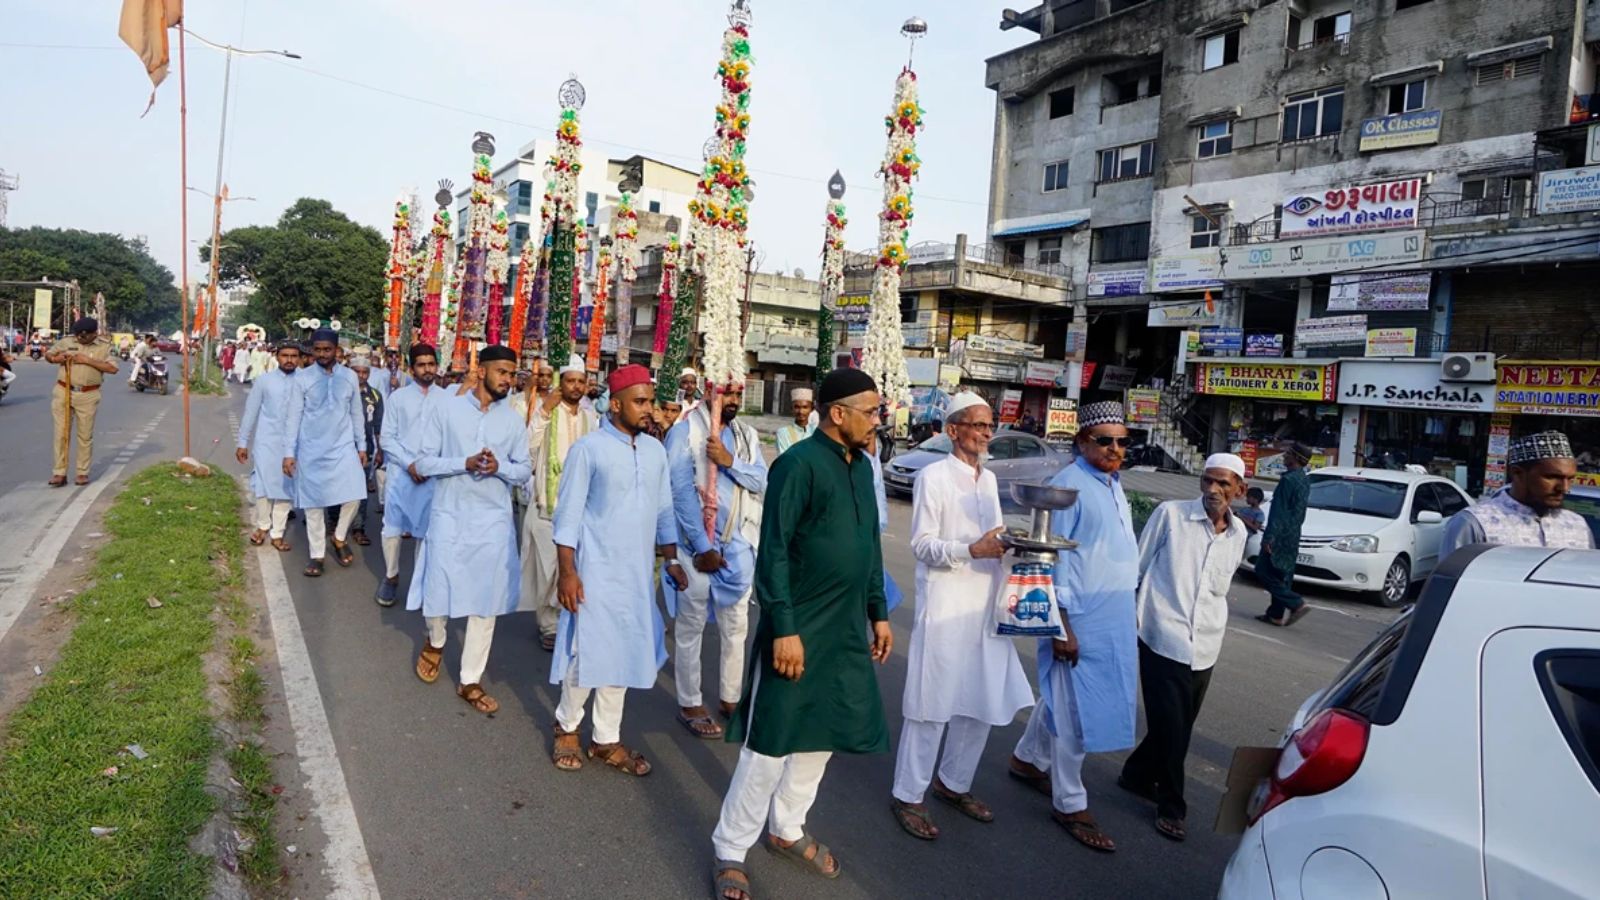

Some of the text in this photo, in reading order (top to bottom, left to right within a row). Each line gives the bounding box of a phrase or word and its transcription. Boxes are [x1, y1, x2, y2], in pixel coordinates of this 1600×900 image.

[1365, 115, 1437, 134] OK Classes
[1231, 366, 1296, 380] BHARAT
[1208, 377, 1320, 391] STATIONERY & XEROX
[1345, 383, 1484, 403] J.P. Sanchala
[1498, 390, 1600, 406] STATIONERY
